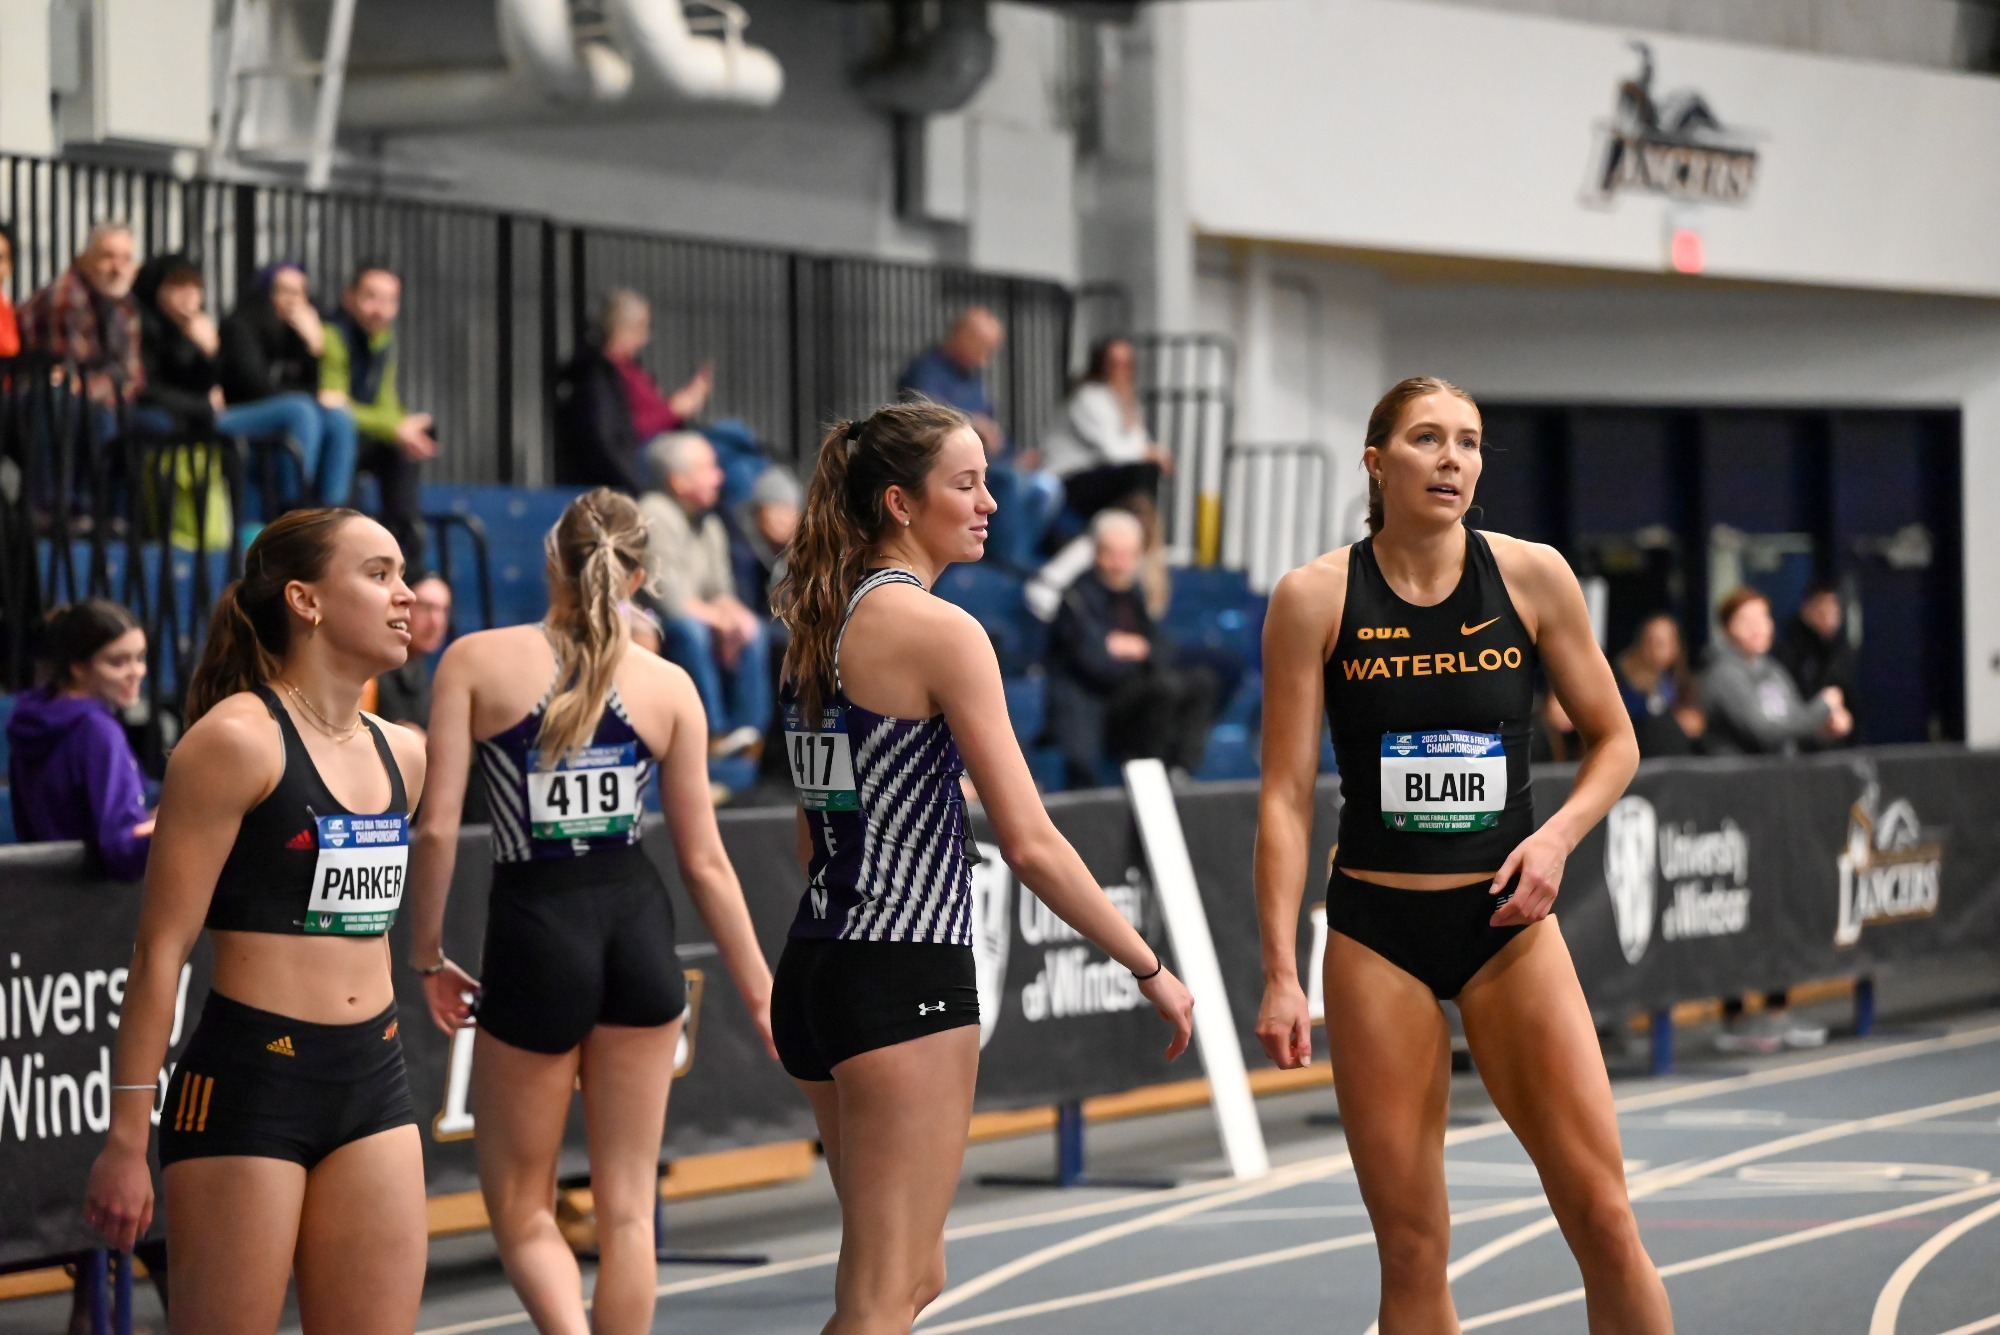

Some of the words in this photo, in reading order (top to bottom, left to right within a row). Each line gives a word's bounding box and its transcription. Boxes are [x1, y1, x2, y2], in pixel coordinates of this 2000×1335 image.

[1357, 627, 1411, 640] OUA
[1342, 646, 1522, 681] WATERLOO
[1421, 735, 1438, 744] 2023
[1438, 734, 1451, 742] OUA
[1451, 733, 1470, 743] TRACK
[1475, 737, 1490, 745] FIELD
[1426, 743, 1487, 755] CHAMPIONSHIPS
[794, 735, 835, 786] 417
[547, 772, 619, 816] 419
[1405, 773, 1485, 801] BLAIR
[355, 830, 400, 844] CHAMPIONSHIPS
[321, 865, 402, 900] PARKER
